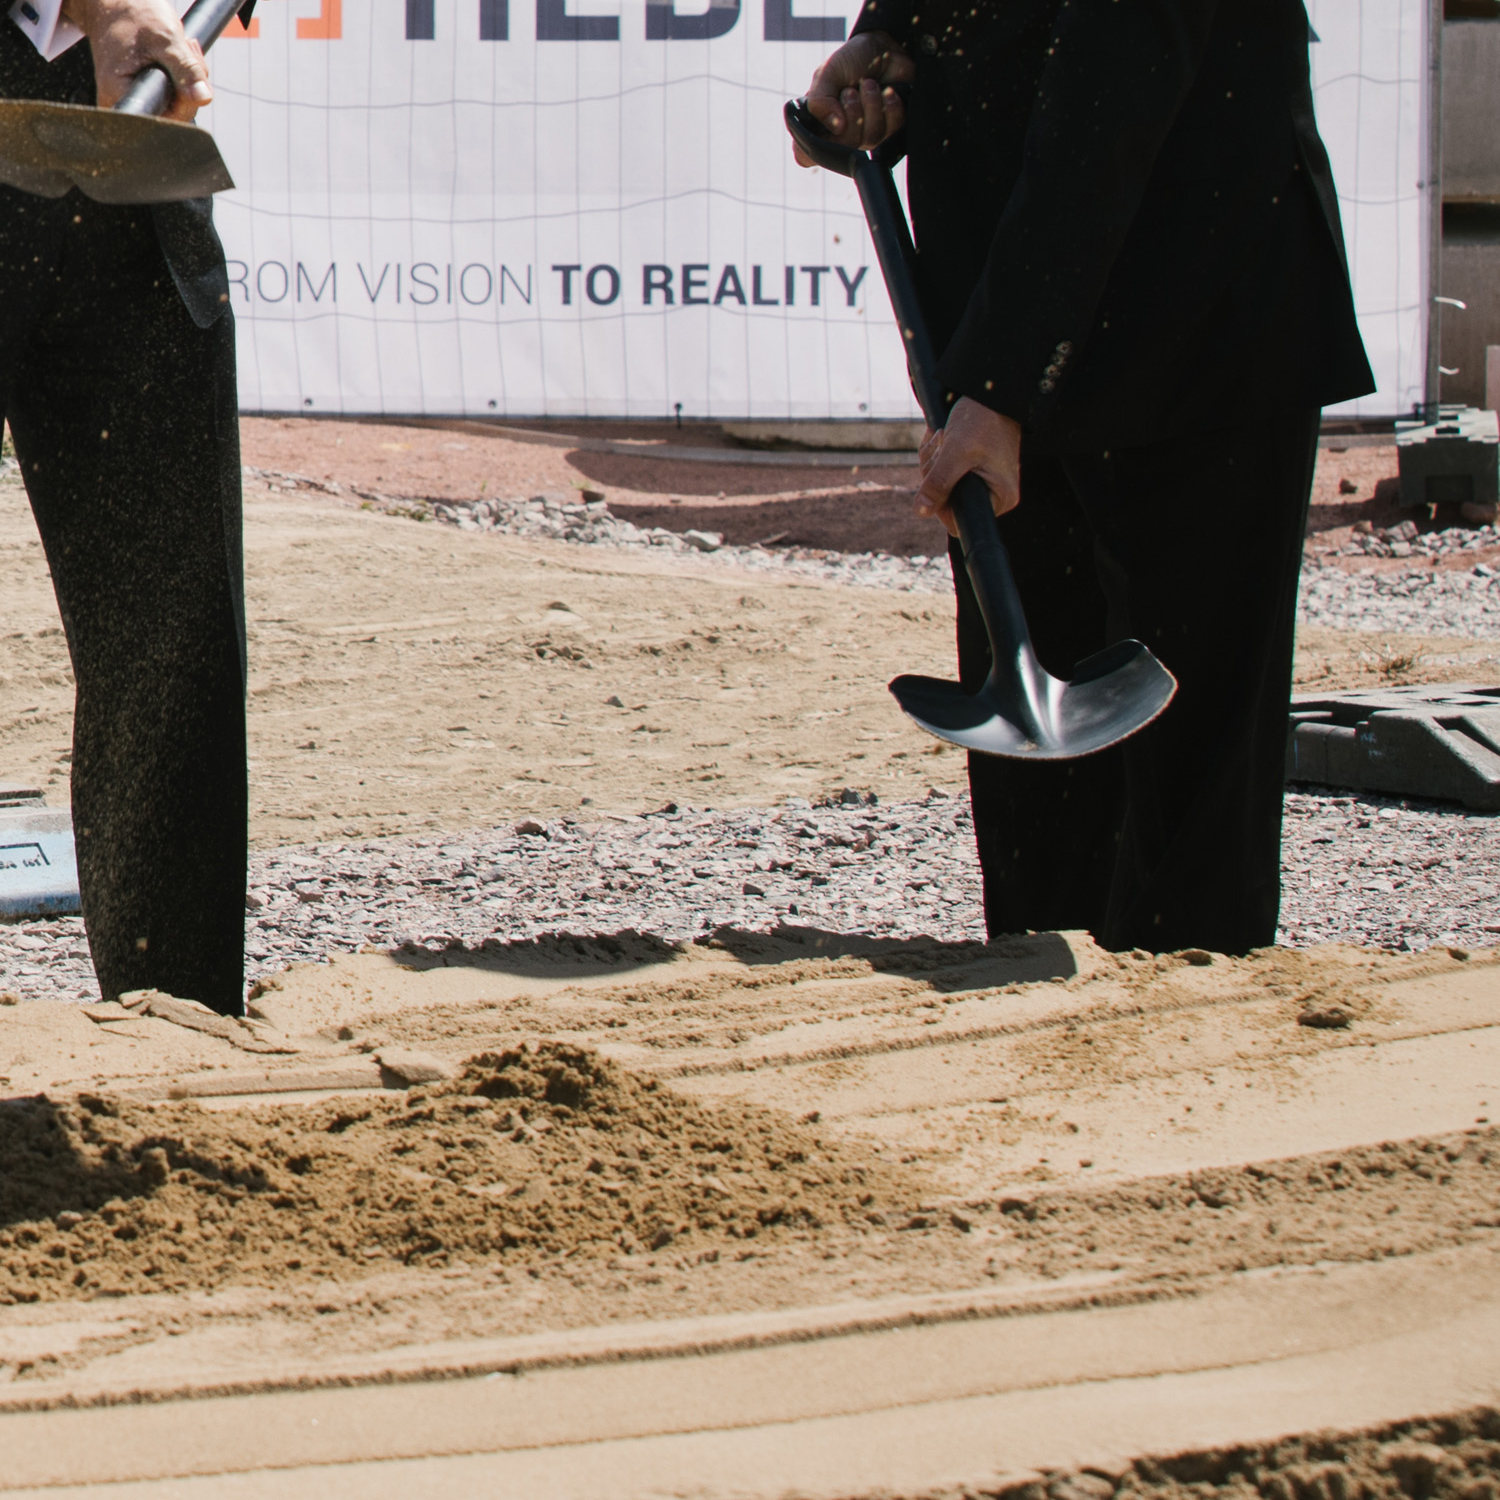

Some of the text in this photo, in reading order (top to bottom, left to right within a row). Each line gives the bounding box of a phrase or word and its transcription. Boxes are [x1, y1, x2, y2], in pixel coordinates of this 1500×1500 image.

[225, 259, 869, 307] ROM VISION TO REALITY
